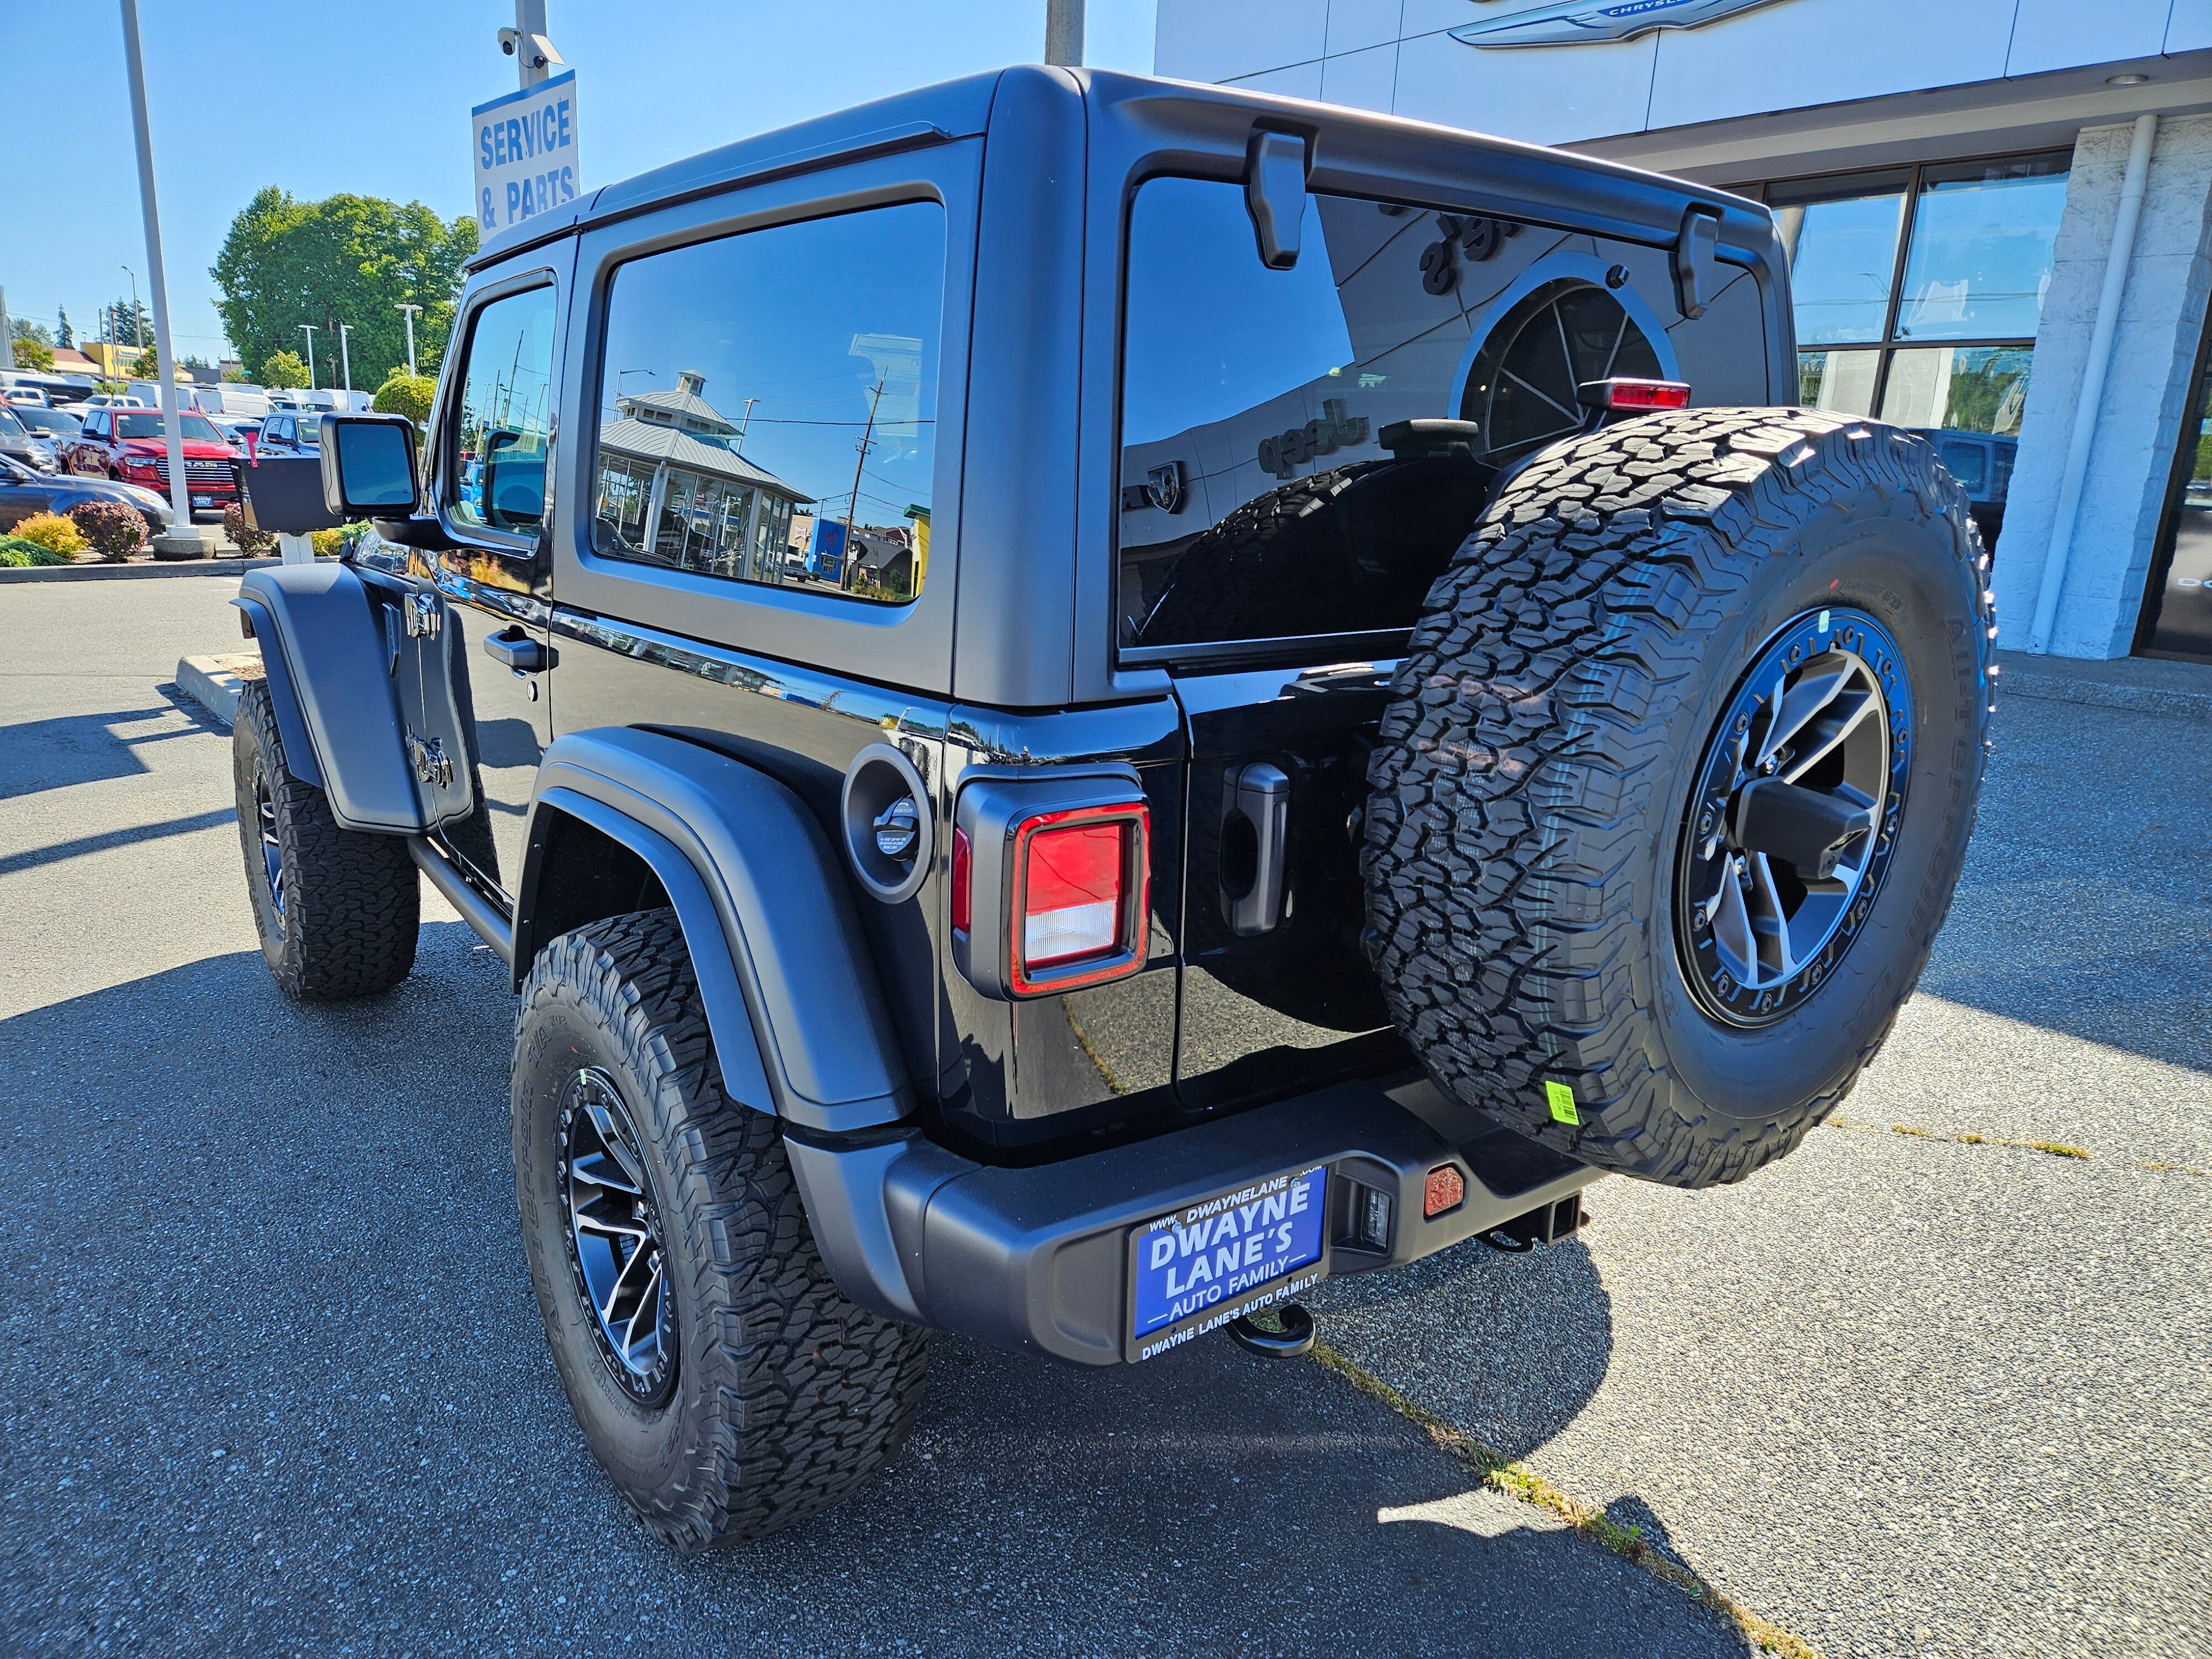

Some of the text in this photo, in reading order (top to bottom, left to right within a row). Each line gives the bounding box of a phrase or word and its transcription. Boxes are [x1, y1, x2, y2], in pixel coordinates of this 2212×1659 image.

[1609, 0, 1684, 15] CHRYSL
[481, 99, 571, 170] SERVICE
[482, 165, 574, 230] & PARTS
[1151, 1183, 1310, 1270] DWAYNE
[1186, 1176, 1288, 1223] DWAYNELANE
[1166, 1222, 1293, 1299] LANE'S
[1169, 1256, 1289, 1322] AUTO FAMILY
[1142, 1273, 1318, 1360] DWAYNE LANE'S AUTO FAMILY
